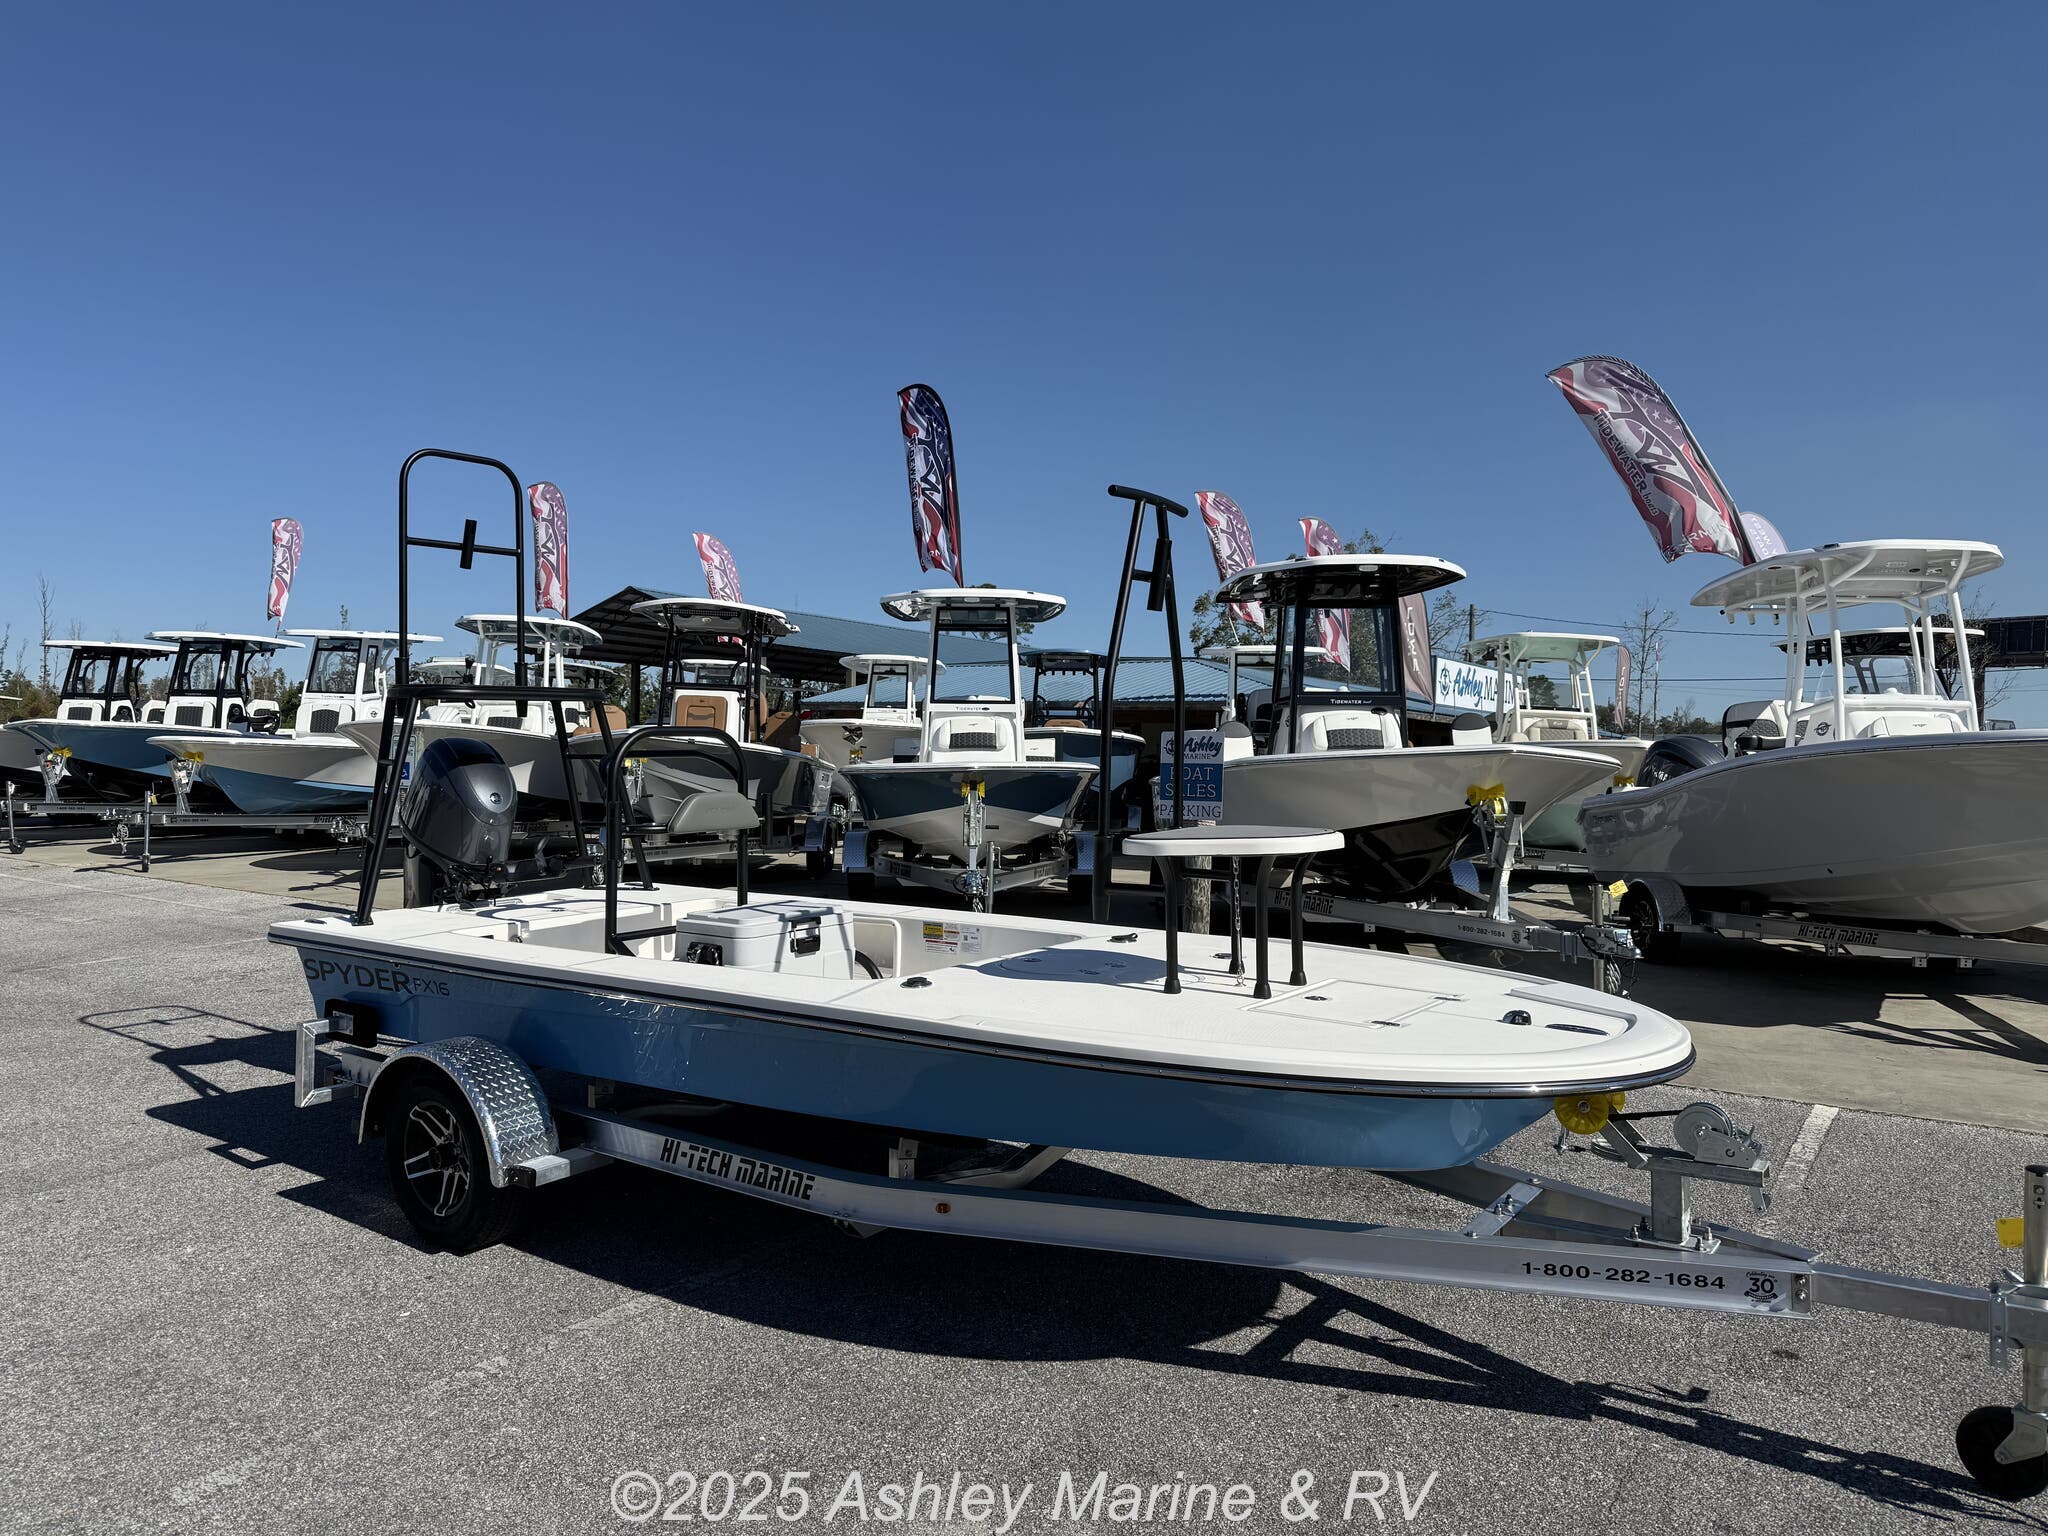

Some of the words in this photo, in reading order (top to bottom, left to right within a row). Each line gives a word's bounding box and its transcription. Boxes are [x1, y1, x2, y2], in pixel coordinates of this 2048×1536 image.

[1593, 408, 1648, 493] TIDEWATER
[1453, 666, 1484, 707] Ashley
[1165, 783, 1216, 798] SLES
[1797, 924, 1837, 940] HI-TECH
[302, 957, 414, 995] SPYDER
[411, 977, 450, 997] FX16
[660, 1137, 733, 1179] HI-TECH
[734, 1157, 816, 1201] MARINE
[1521, 1260, 1726, 1290] 1-800-282-1684
